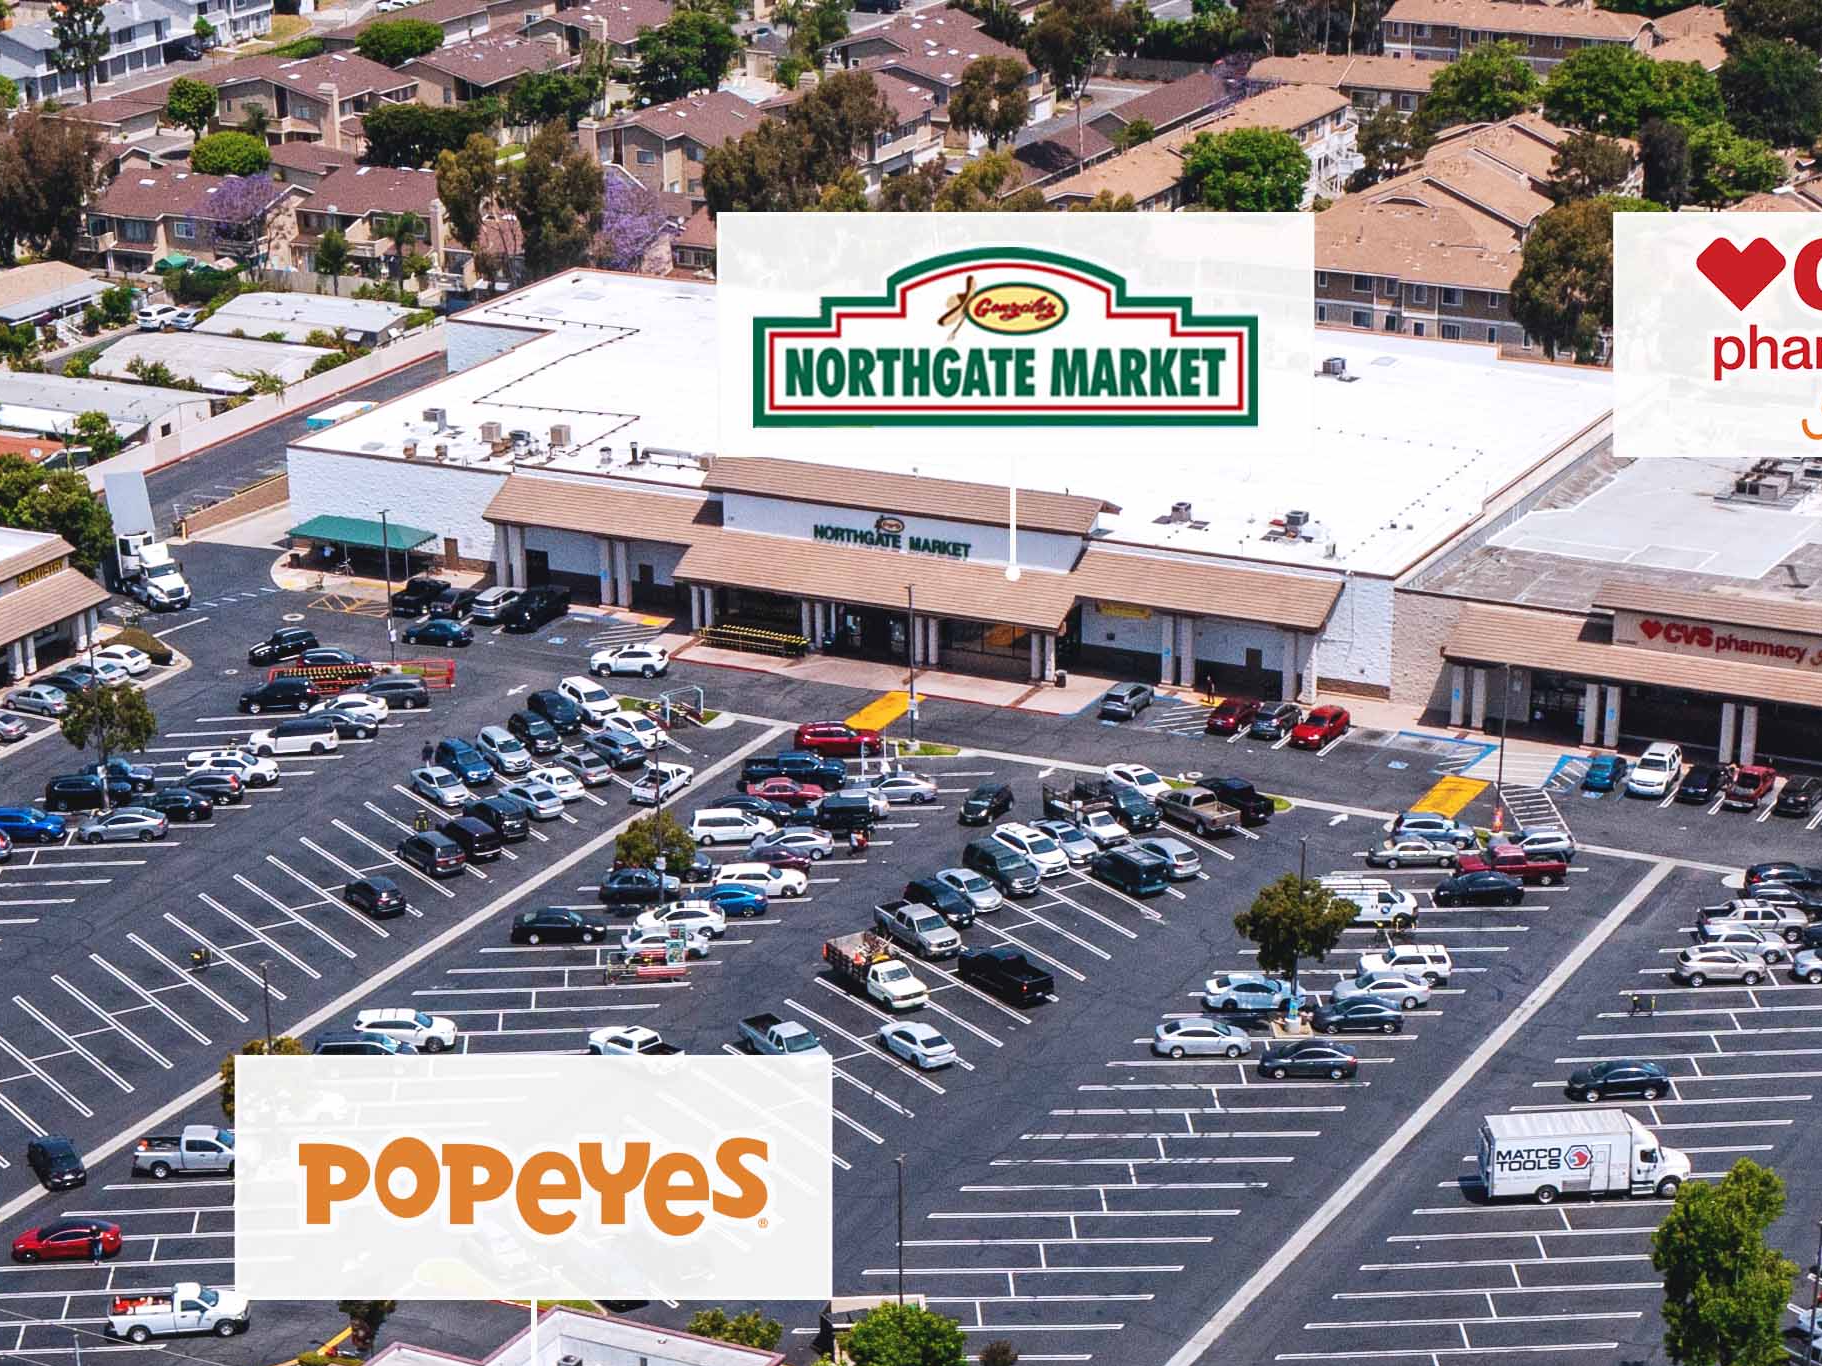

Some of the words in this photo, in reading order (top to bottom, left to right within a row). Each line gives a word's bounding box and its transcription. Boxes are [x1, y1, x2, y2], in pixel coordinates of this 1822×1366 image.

[813, 524, 901, 549] NORTHGATE
[909, 536, 972, 558] MARKET
[18, 559, 65, 588] DENTISTRY
[1663, 622, 1714, 648] CVS
[1715, 634, 1807, 664] pharmacy
[1496, 1147, 1562, 1161] MATCO
[1496, 1158, 1562, 1172] TOOLS
